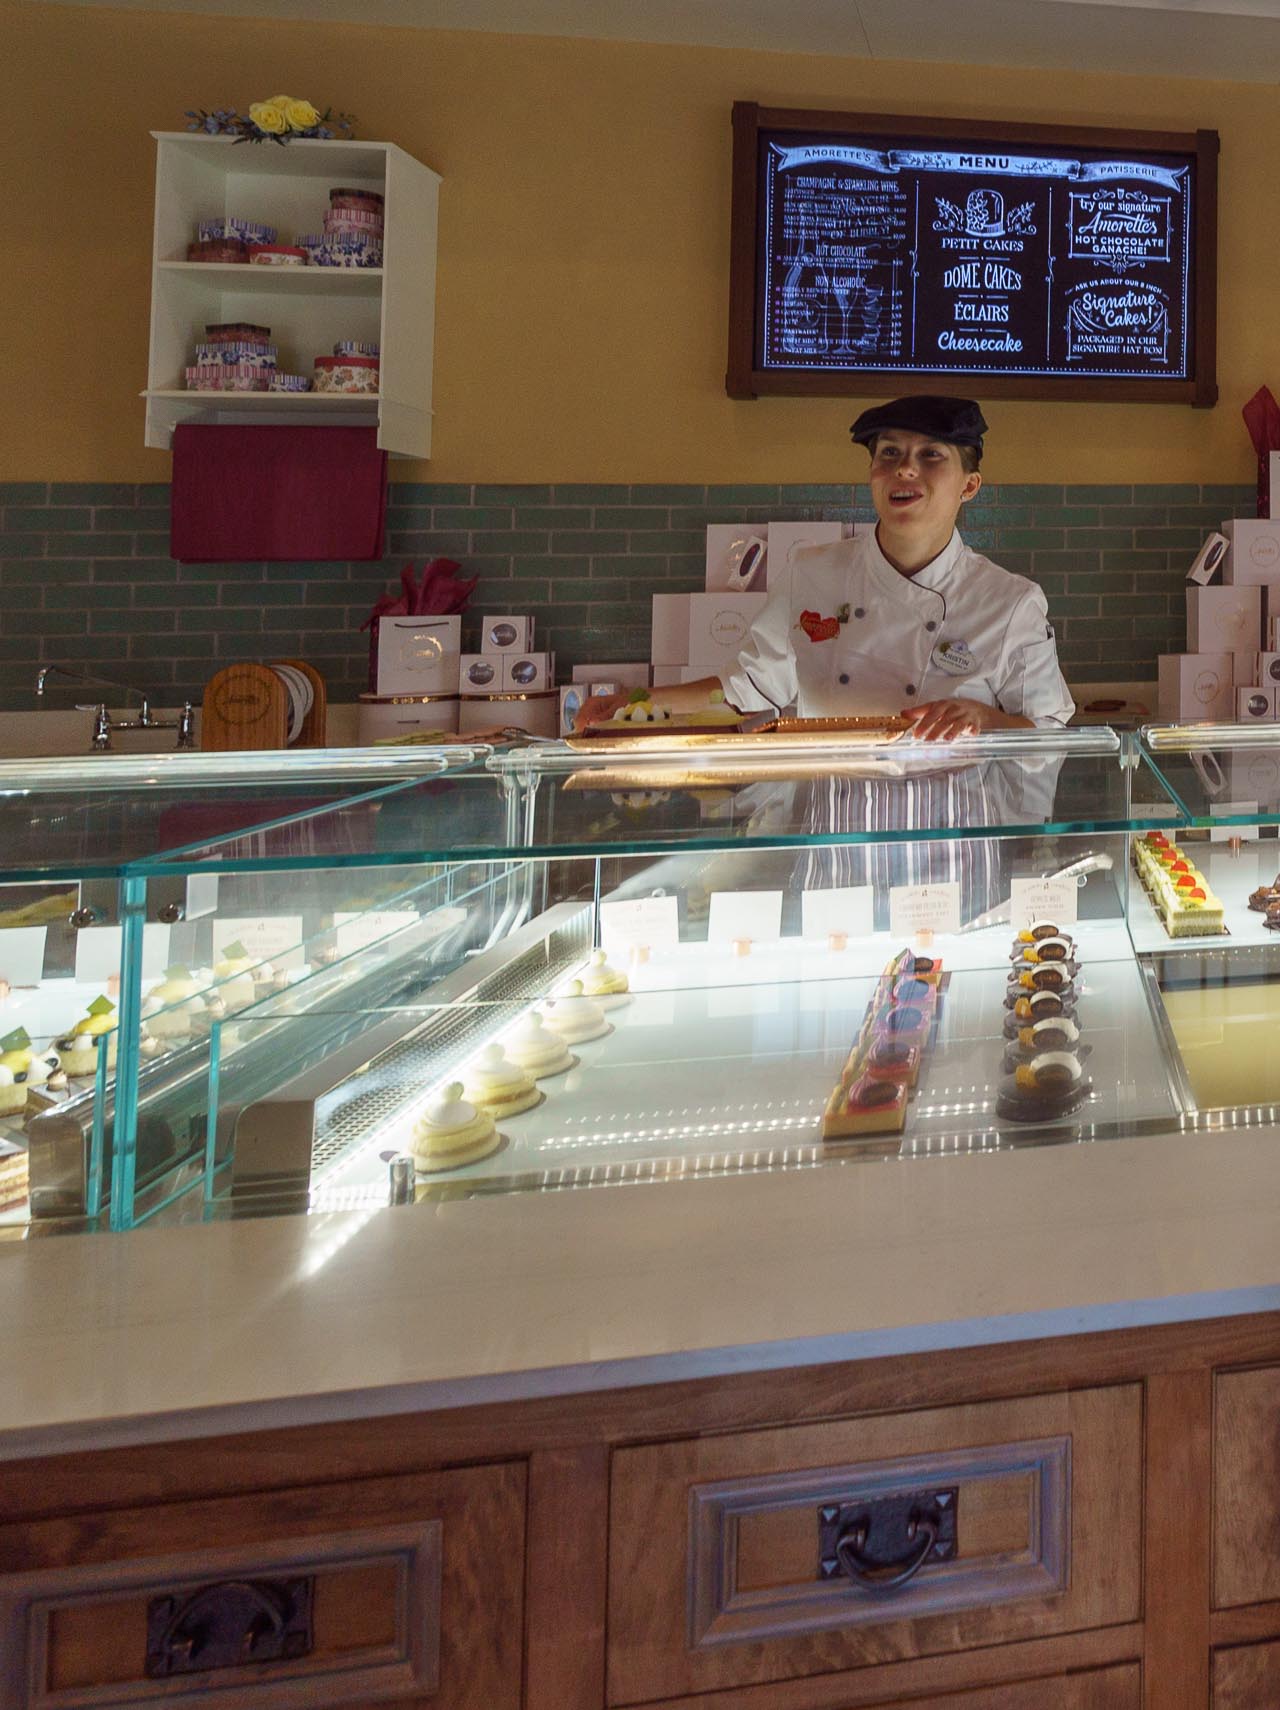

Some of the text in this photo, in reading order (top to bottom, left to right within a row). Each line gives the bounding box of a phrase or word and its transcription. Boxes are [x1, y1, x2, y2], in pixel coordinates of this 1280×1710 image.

[804, 149, 871, 161] AMORETTE'S
[959, 156, 1009, 169] MENU
[797, 176, 836, 189] CHAMPAGNE
[1080, 197, 1161, 214] try our signature
[1078, 211, 1157, 234] Amorette's
[942, 237, 1024, 252] PETIT CAKES
[1075, 235, 1164, 247] HOT CHOCOLATE
[830, 246, 866, 258] CHOCOLATE
[944, 262, 1022, 291] DOME CAKES
[1075, 282, 1088, 291] ASK
[1124, 279, 1139, 287] OUR
[1146, 283, 1162, 294] INCH
[1083, 290, 1157, 315] Signature
[954, 300, 1009, 322] ÉCLAIRS
[1105, 305, 1152, 327] Cakes!
[937, 331, 1023, 353] Cheesecake
[1078, 334, 1157, 345] PACKAGED IN OUR
[1072, 344, 1120, 353] SIGNATURE
[944, 653, 970, 666] KRISTIN
